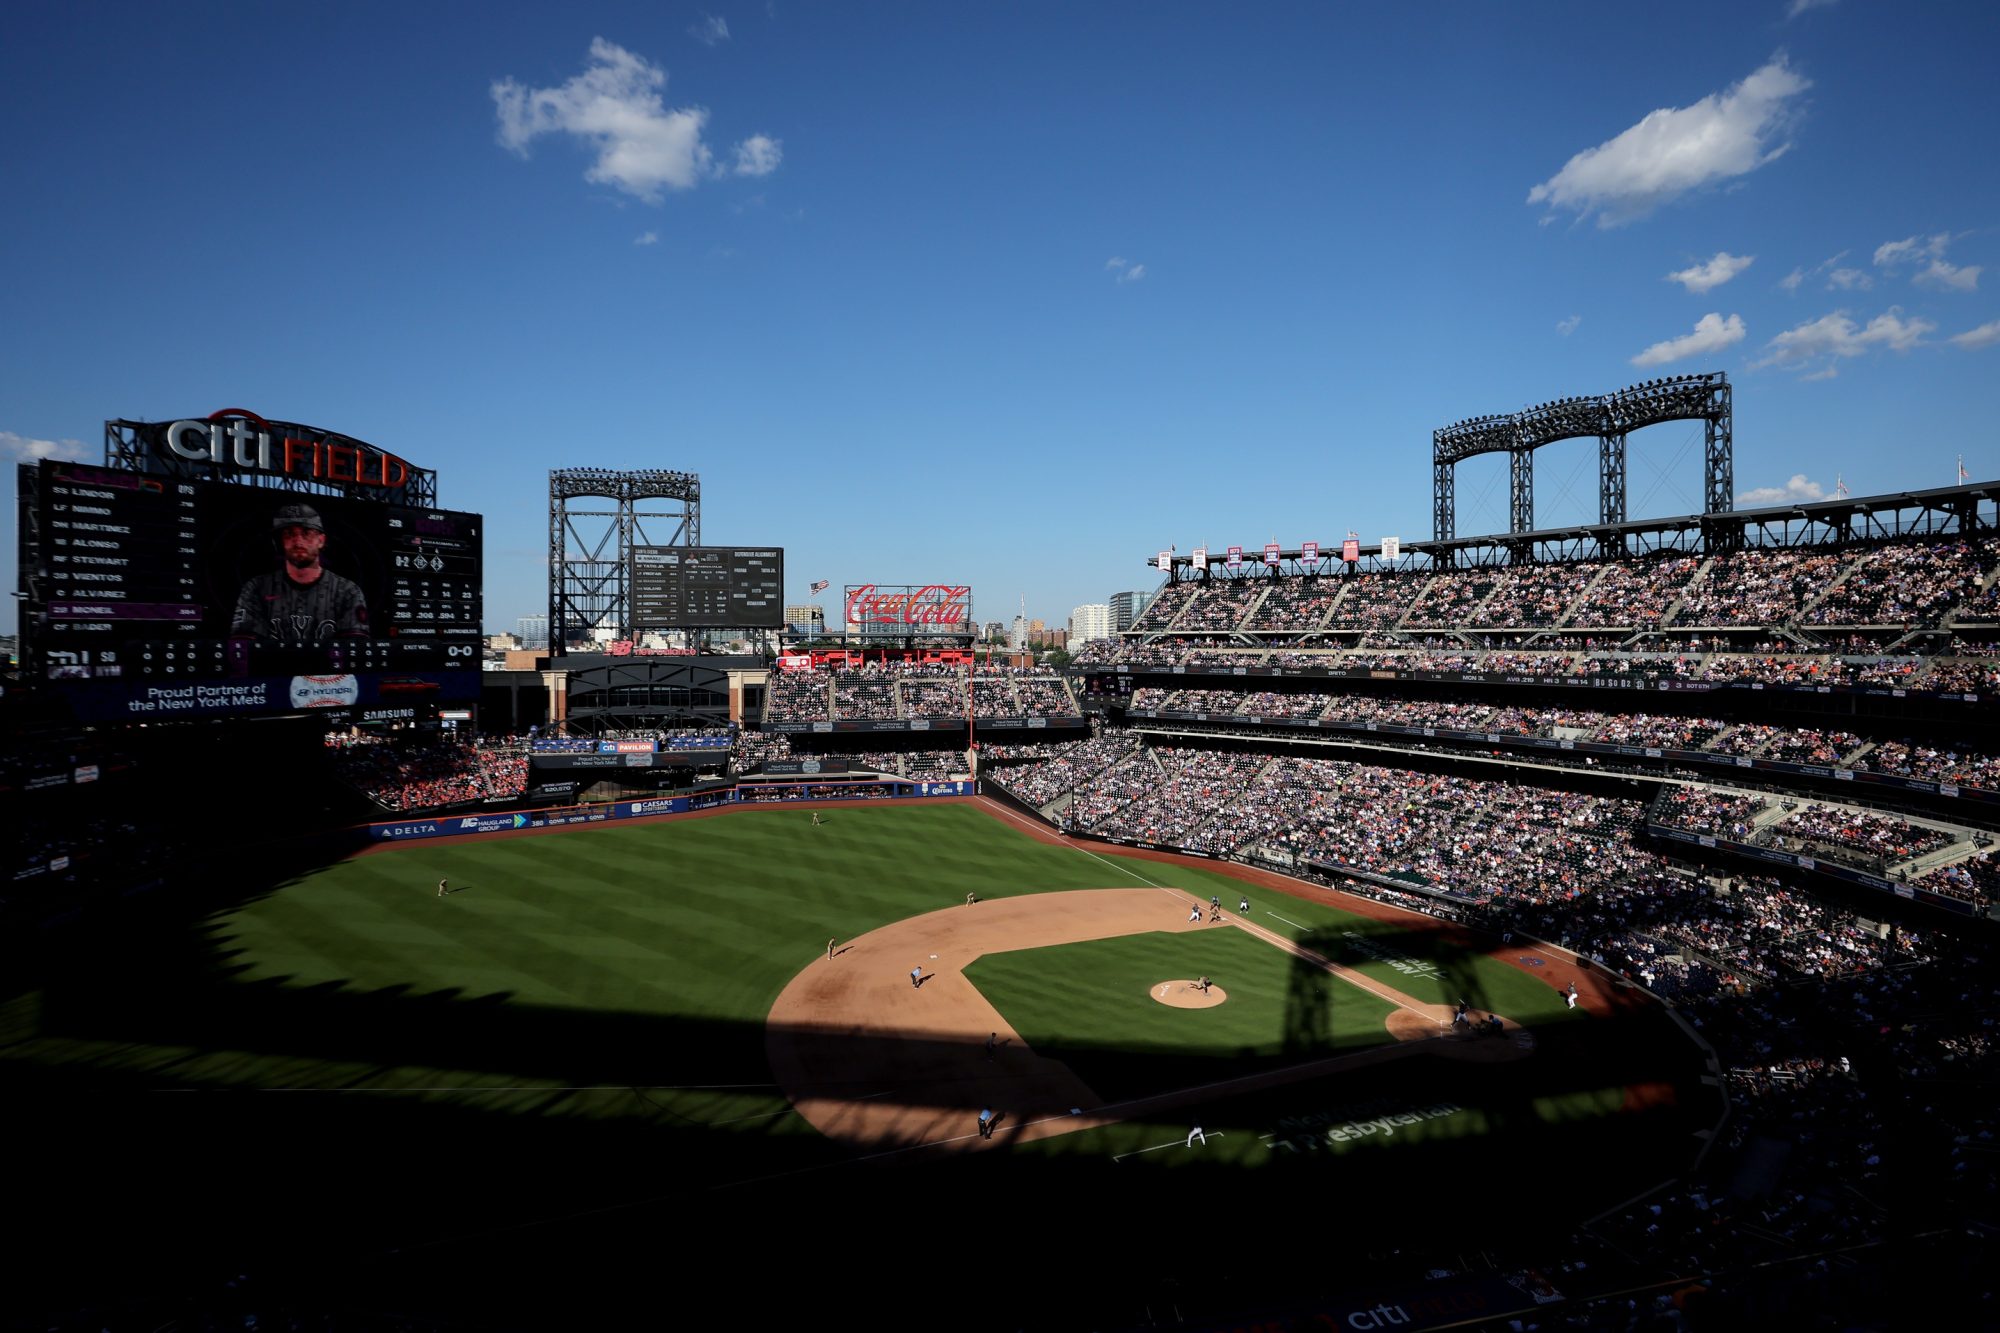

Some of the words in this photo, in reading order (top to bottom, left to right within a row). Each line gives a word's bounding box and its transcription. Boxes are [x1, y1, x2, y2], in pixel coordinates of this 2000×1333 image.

[167, 418, 271, 470] citi
[284, 437, 408, 488] FIELD
[72, 488, 116, 500] LINDOR
[52, 504, 69, 512] LF
[72, 504, 112, 516] NIMMO
[72, 522, 131, 534] MARTINEZ
[72, 538, 120, 550] ALONSO
[72, 556, 130, 566] STEWART
[395, 556, 410, 568] 0-2
[72, 572, 123, 582] VIENTOS
[72, 589, 127, 599] ALVAREZ
[72, 606, 116, 614] MCNEIL
[846, 584, 970, 624] Coca-Cola
[72, 623, 113, 631] BADER
[448, 646, 473, 656] 0-0
[143, 666, 152, 674] 0
[148, 686, 194, 698] Proud
[197, 684, 246, 697] Partner
[250, 683, 266, 695] of
[128, 700, 155, 712] the
[158, 698, 194, 710] New
[197, 696, 229, 707] York
[231, 694, 266, 706] Mets
[363, 708, 414, 720] SAMSUNG
[602, 743, 615, 751] citi
[394, 825, 436, 835] DELTA
[1347, 1302, 1412, 1330] citi
